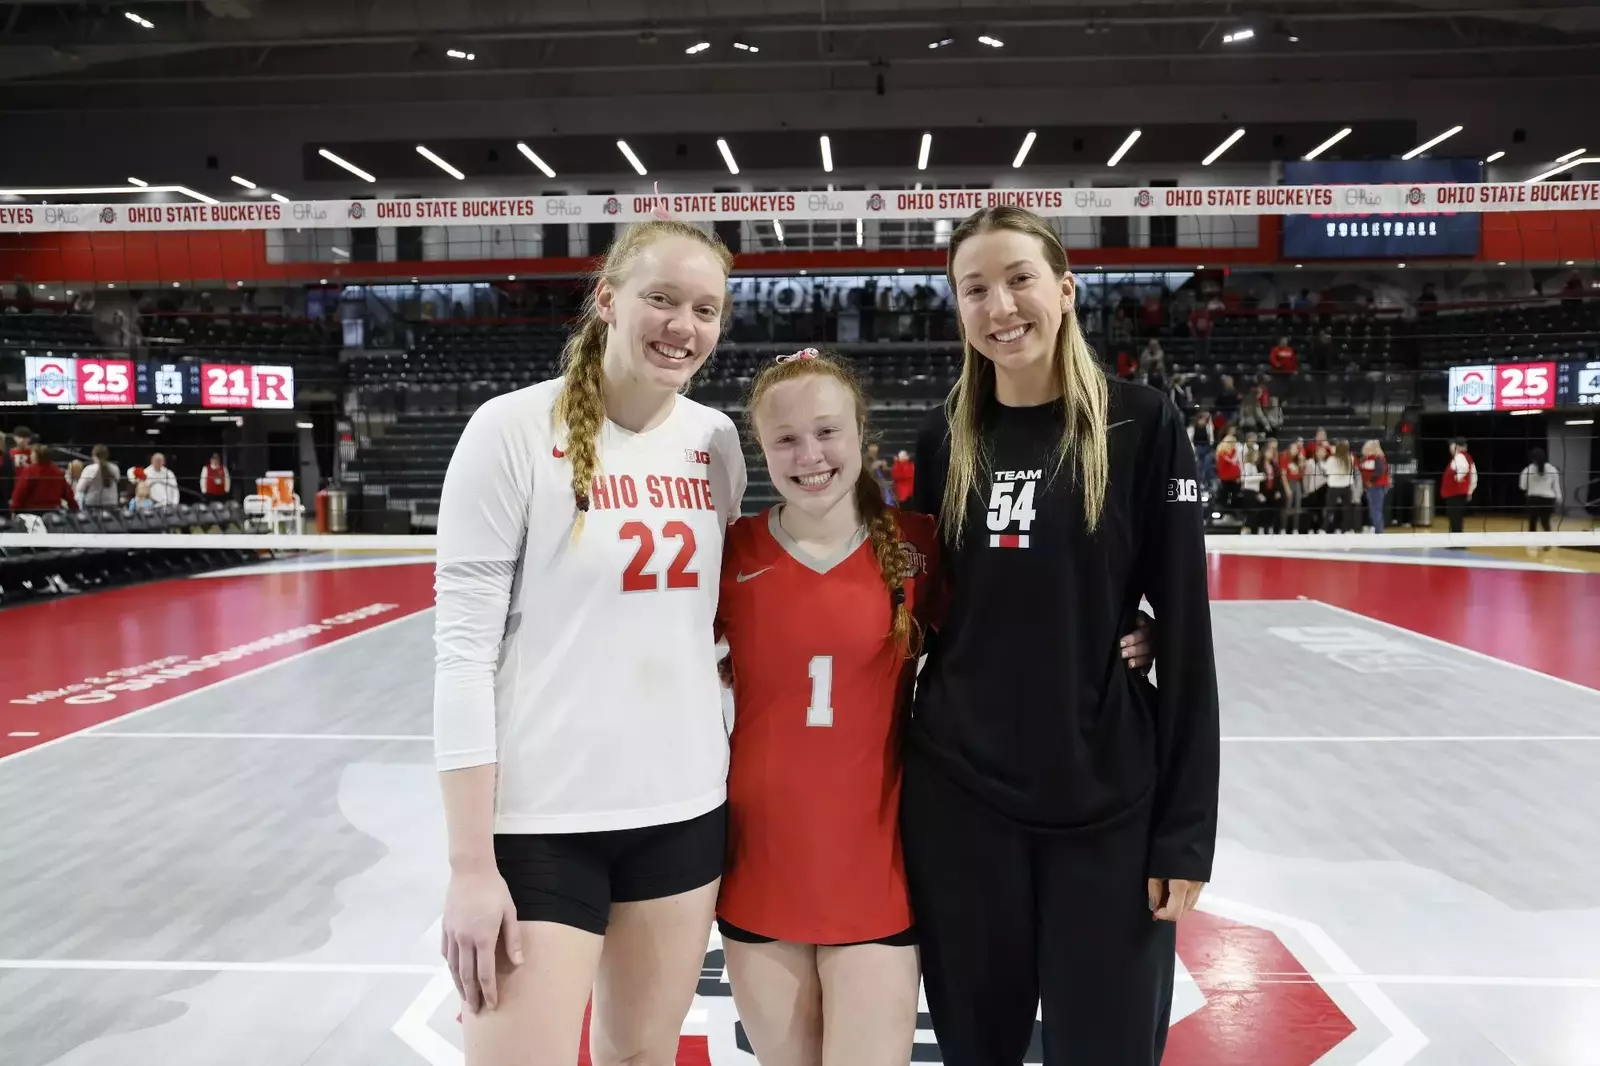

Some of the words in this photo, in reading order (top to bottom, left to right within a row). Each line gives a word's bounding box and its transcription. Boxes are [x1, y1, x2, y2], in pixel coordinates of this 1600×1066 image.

[674, 196, 716, 212] STATE
[721, 195, 795, 212] BUCKEYES
[897, 193, 934, 210] OHIO
[939, 192, 982, 209] STATE
[987, 191, 1062, 208] BUCKEYES
[1165, 189, 1203, 206] OHIO
[1207, 189, 1251, 206] STATE
[1256, 188, 1332, 205] BUCKEYES
[1437, 187, 1475, 204] OHIO
[1479, 185, 1526, 203] STATE
[1530, 183, 1600, 202] BUCKEYE
[128, 207, 162, 223] OHIO
[166, 206, 207, 222] STATE
[211, 204, 281, 221] BUCKEYES
[377, 202, 411, 218] OHIO
[416, 201, 457, 217] STATE
[463, 200, 534, 217] BUCKEYES
[82, 363, 129, 393] 25
[206, 368, 249, 396] 21
[256, 373, 288, 401] R
[1501, 367, 1549, 398] 25
[994, 469, 1043, 481] TEAM
[591, 474, 639, 510] HIO
[646, 474, 716, 511] STATE
[986, 481, 1037, 532] 54
[618, 519, 700, 594] 22
[806, 655, 834, 727] 1
